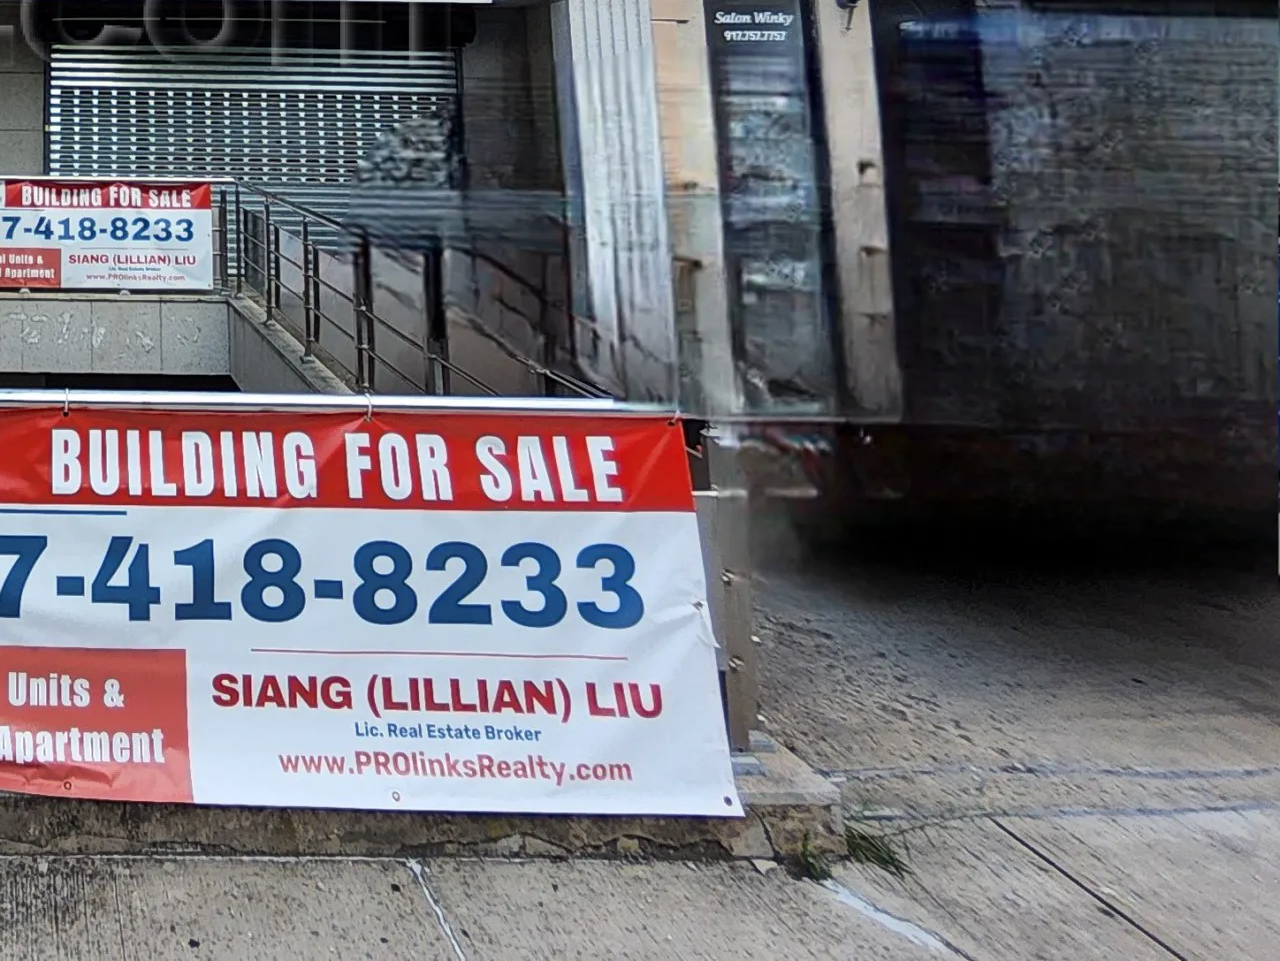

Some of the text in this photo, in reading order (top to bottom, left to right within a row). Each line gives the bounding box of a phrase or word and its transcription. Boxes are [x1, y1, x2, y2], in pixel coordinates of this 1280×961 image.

[714, 11, 794, 26] Salon Winky
[21, 186, 191, 208] BUILDING FOR SALE
[9, 253, 34, 265] Units
[36, 254, 44, 265] &
[68, 254, 196, 267] SIANG (LILLIAN) LIU
[4, 268, 55, 280] Apartment
[51, 428, 624, 504] BUILDING FOR SALE
[7, 672, 92, 708] Units
[103, 678, 126, 708] &
[211, 673, 663, 723] SIANG (LILLIAN) LIU
[354, 721, 542, 742] Lic. Real Estate Broker
[278, 750, 634, 786] www.PROlinksRealty.com
